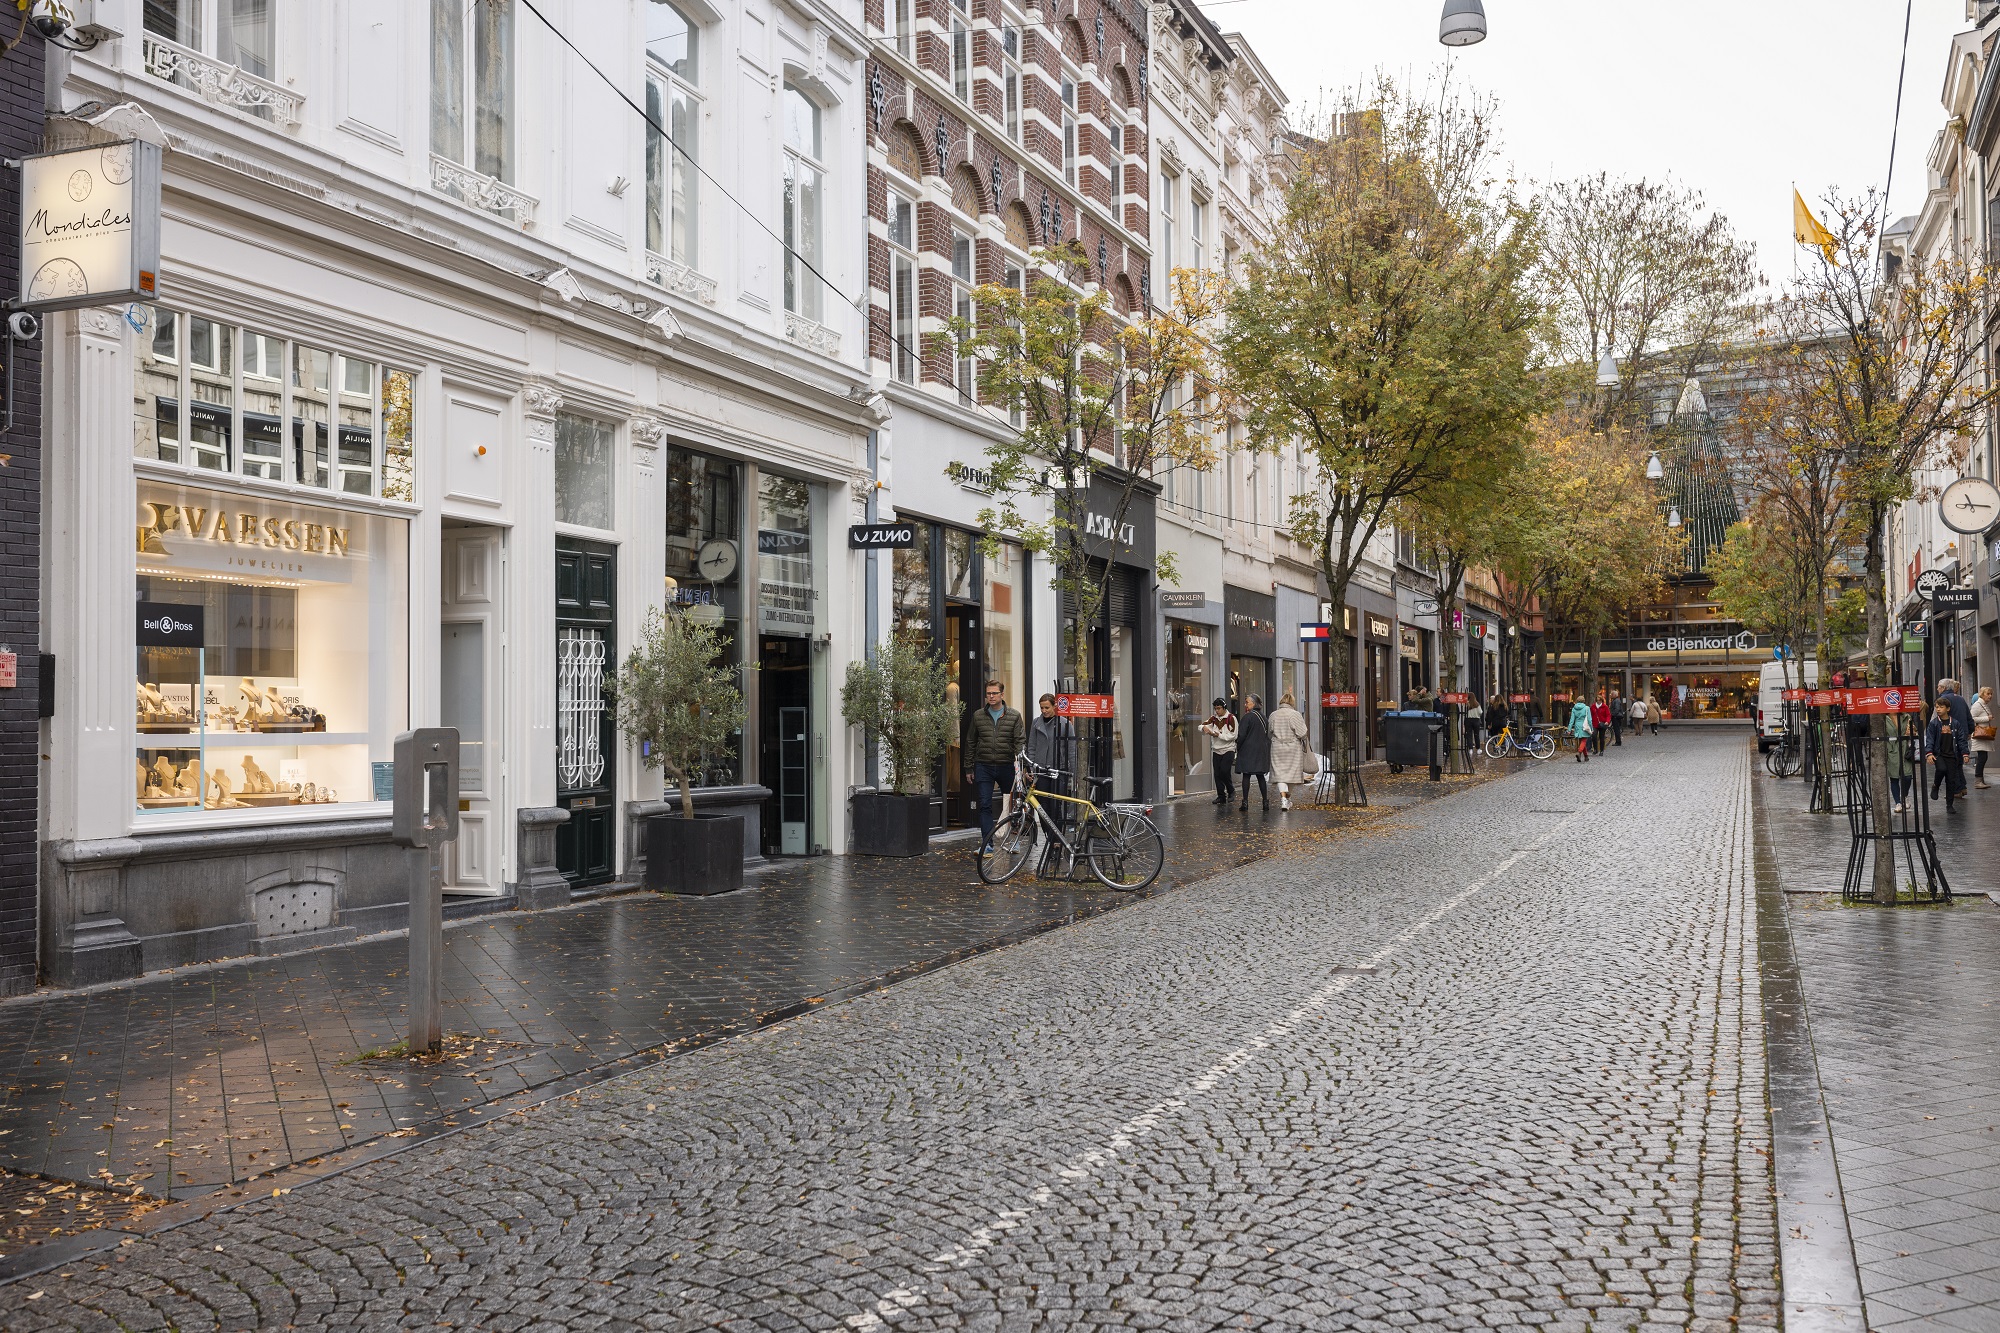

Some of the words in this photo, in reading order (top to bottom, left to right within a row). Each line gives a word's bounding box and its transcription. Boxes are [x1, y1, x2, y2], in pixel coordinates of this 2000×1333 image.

[24, 208, 131, 237] Mondiales
[182, 506, 350, 556] VAESSEN
[870, 529, 912, 543] ZUMO
[228, 556, 303, 573] JUWELIER
[1162, 594, 1186, 602] CALVIN
[1938, 594, 1954, 602] VAN
[144, 619, 160, 630] Bell
[174, 620, 193, 631] Ross
[143, 645, 192, 655] VAESSEN
[1647, 638, 1666, 651] de
[1667, 636, 1733, 652] Bijenkorf
[162, 694, 190, 703] CVSTOS
